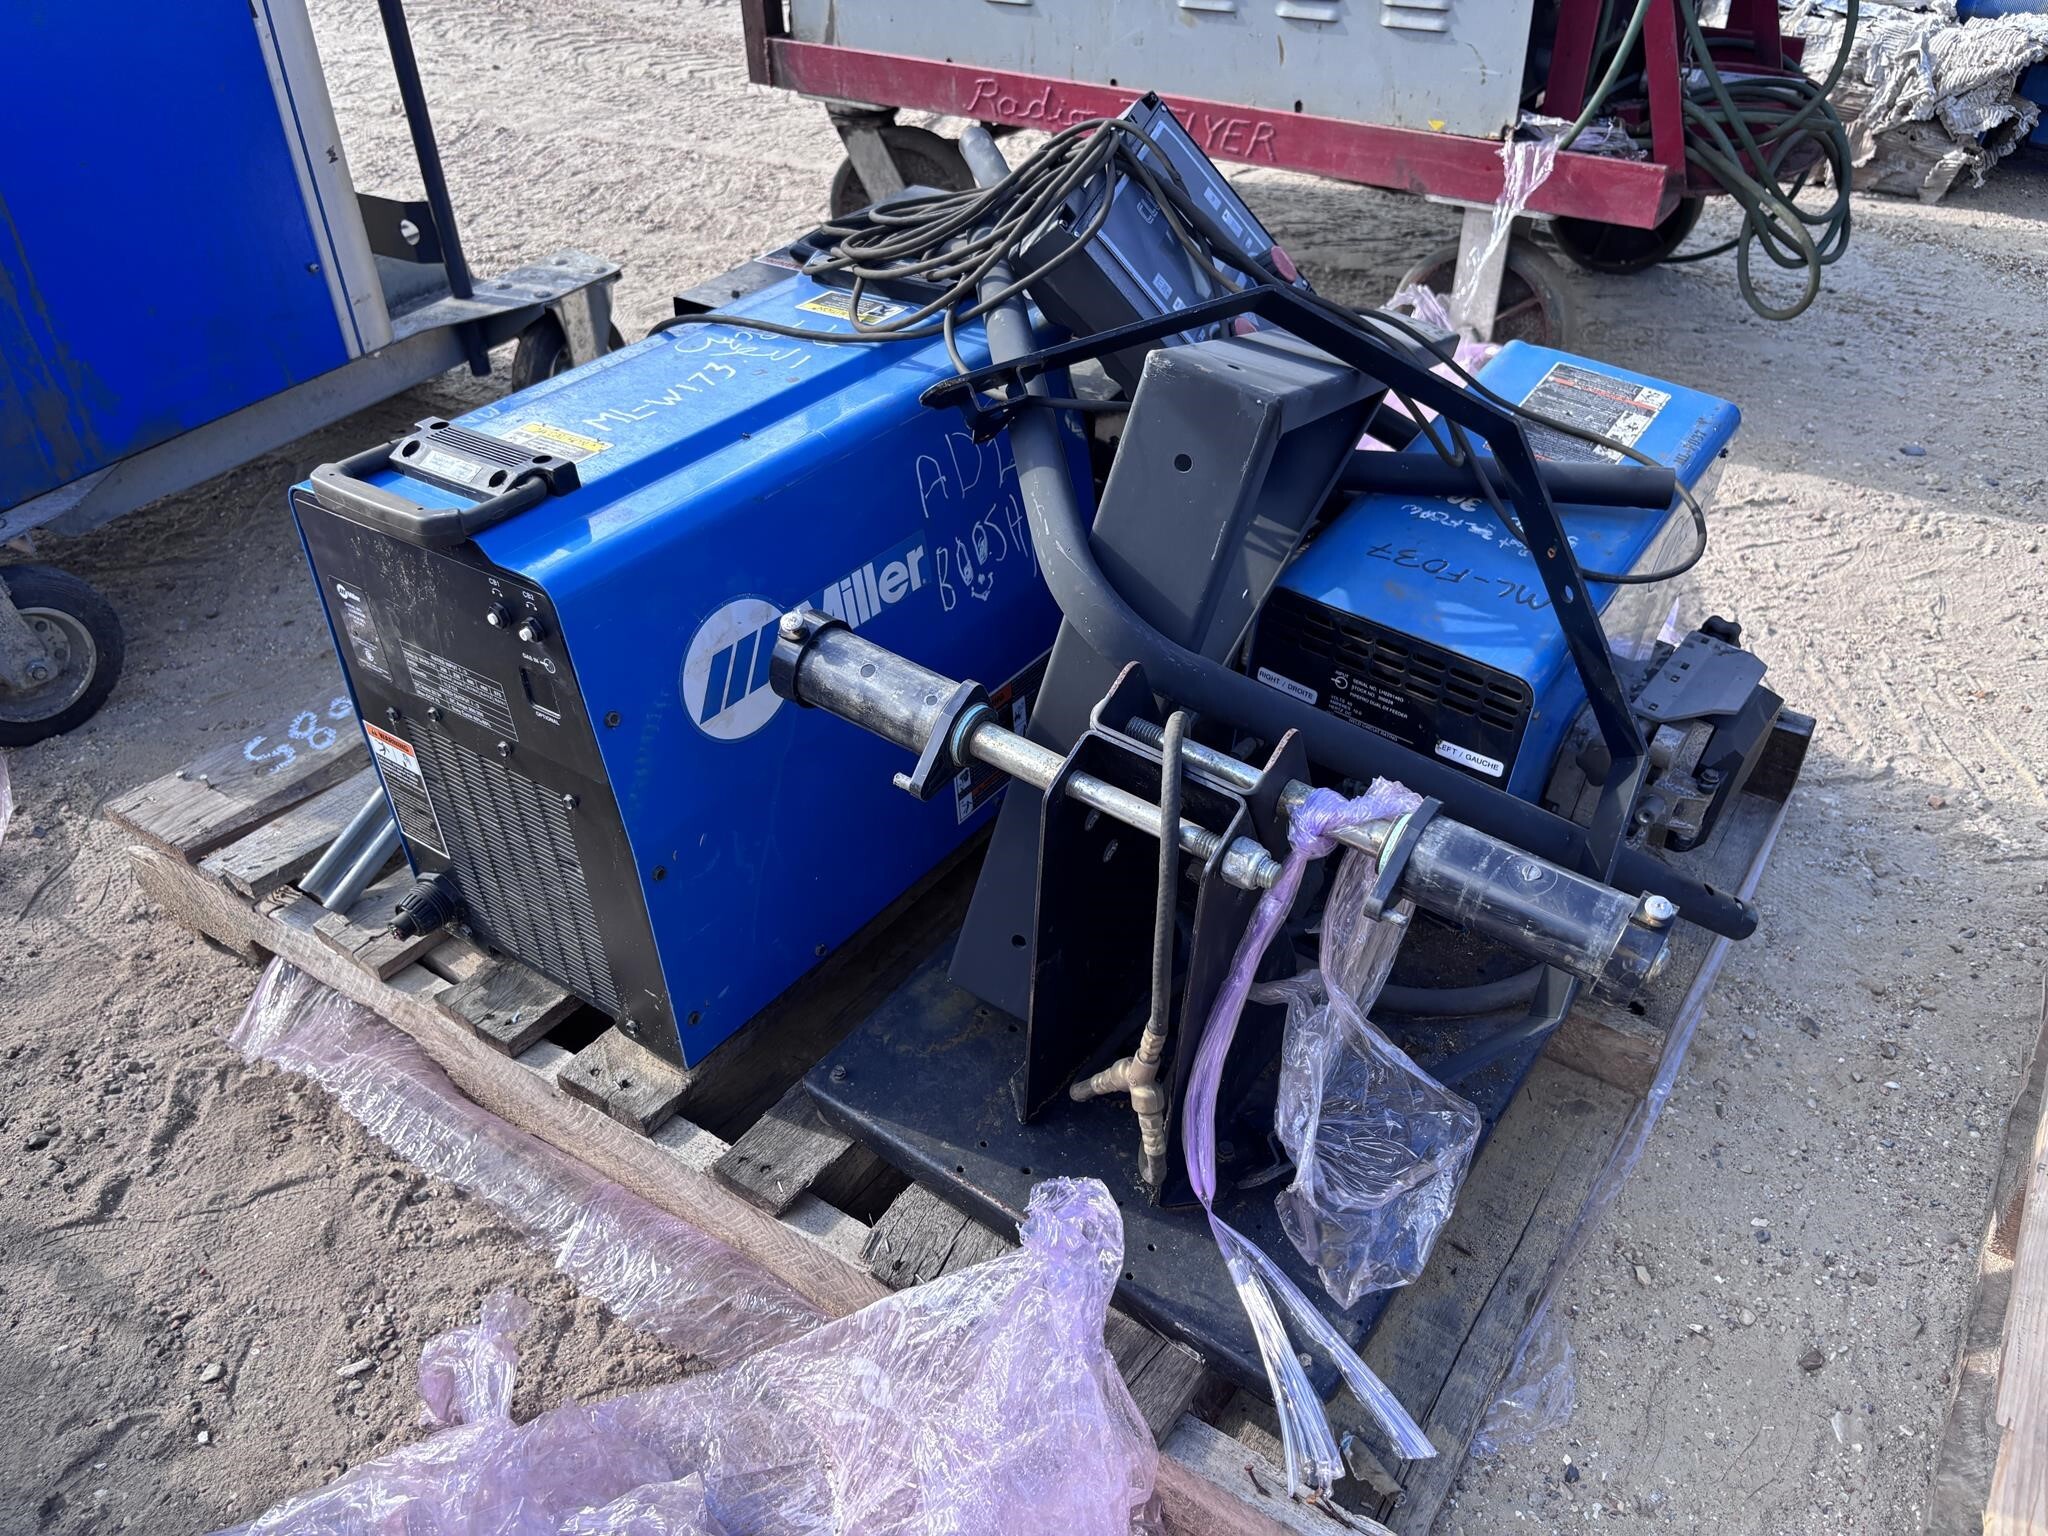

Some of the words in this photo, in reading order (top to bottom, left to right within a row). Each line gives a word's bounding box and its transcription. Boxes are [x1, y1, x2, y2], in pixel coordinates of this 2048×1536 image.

[936, 494, 1037, 612] BOOSH
[1259, 670, 1280, 684] RIGHT
[1287, 684, 1314, 700] DROITE
[1465, 753, 1499, 771] GAUCHE
